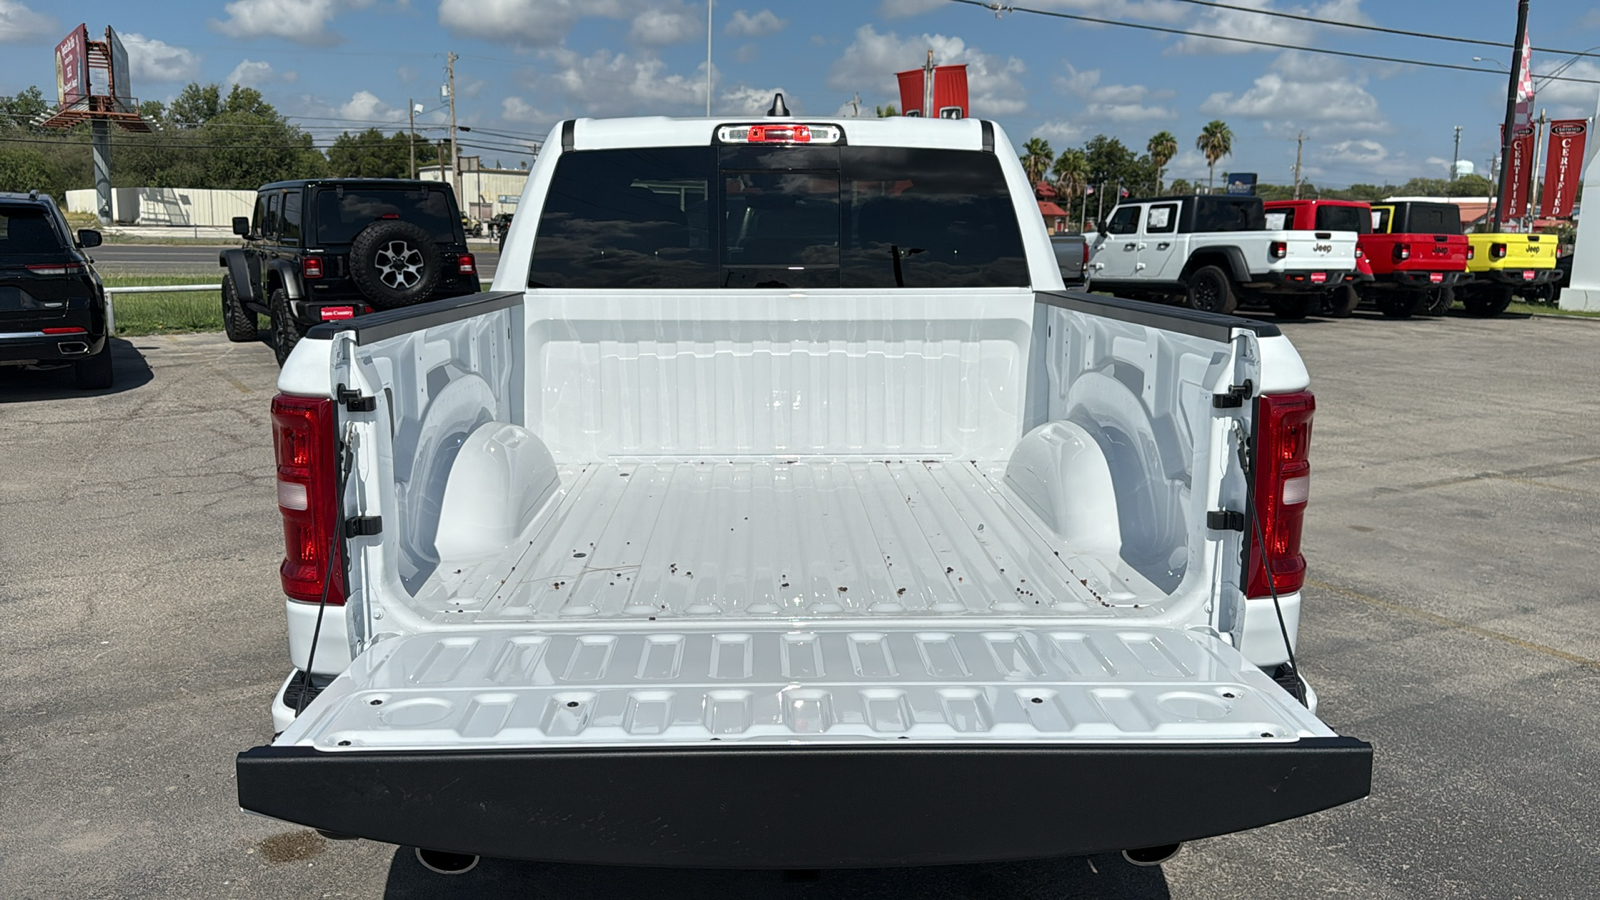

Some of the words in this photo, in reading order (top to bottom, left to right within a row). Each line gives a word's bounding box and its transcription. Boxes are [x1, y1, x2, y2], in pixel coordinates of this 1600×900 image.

[1509, 140, 1522, 216] CERTIFIED
[1552, 138, 1572, 215] CERTIFIED
[1313, 243, 1332, 254] Jeep
[1432, 245, 1448, 255] Jeep
[1526, 244, 1540, 254] Jeep
